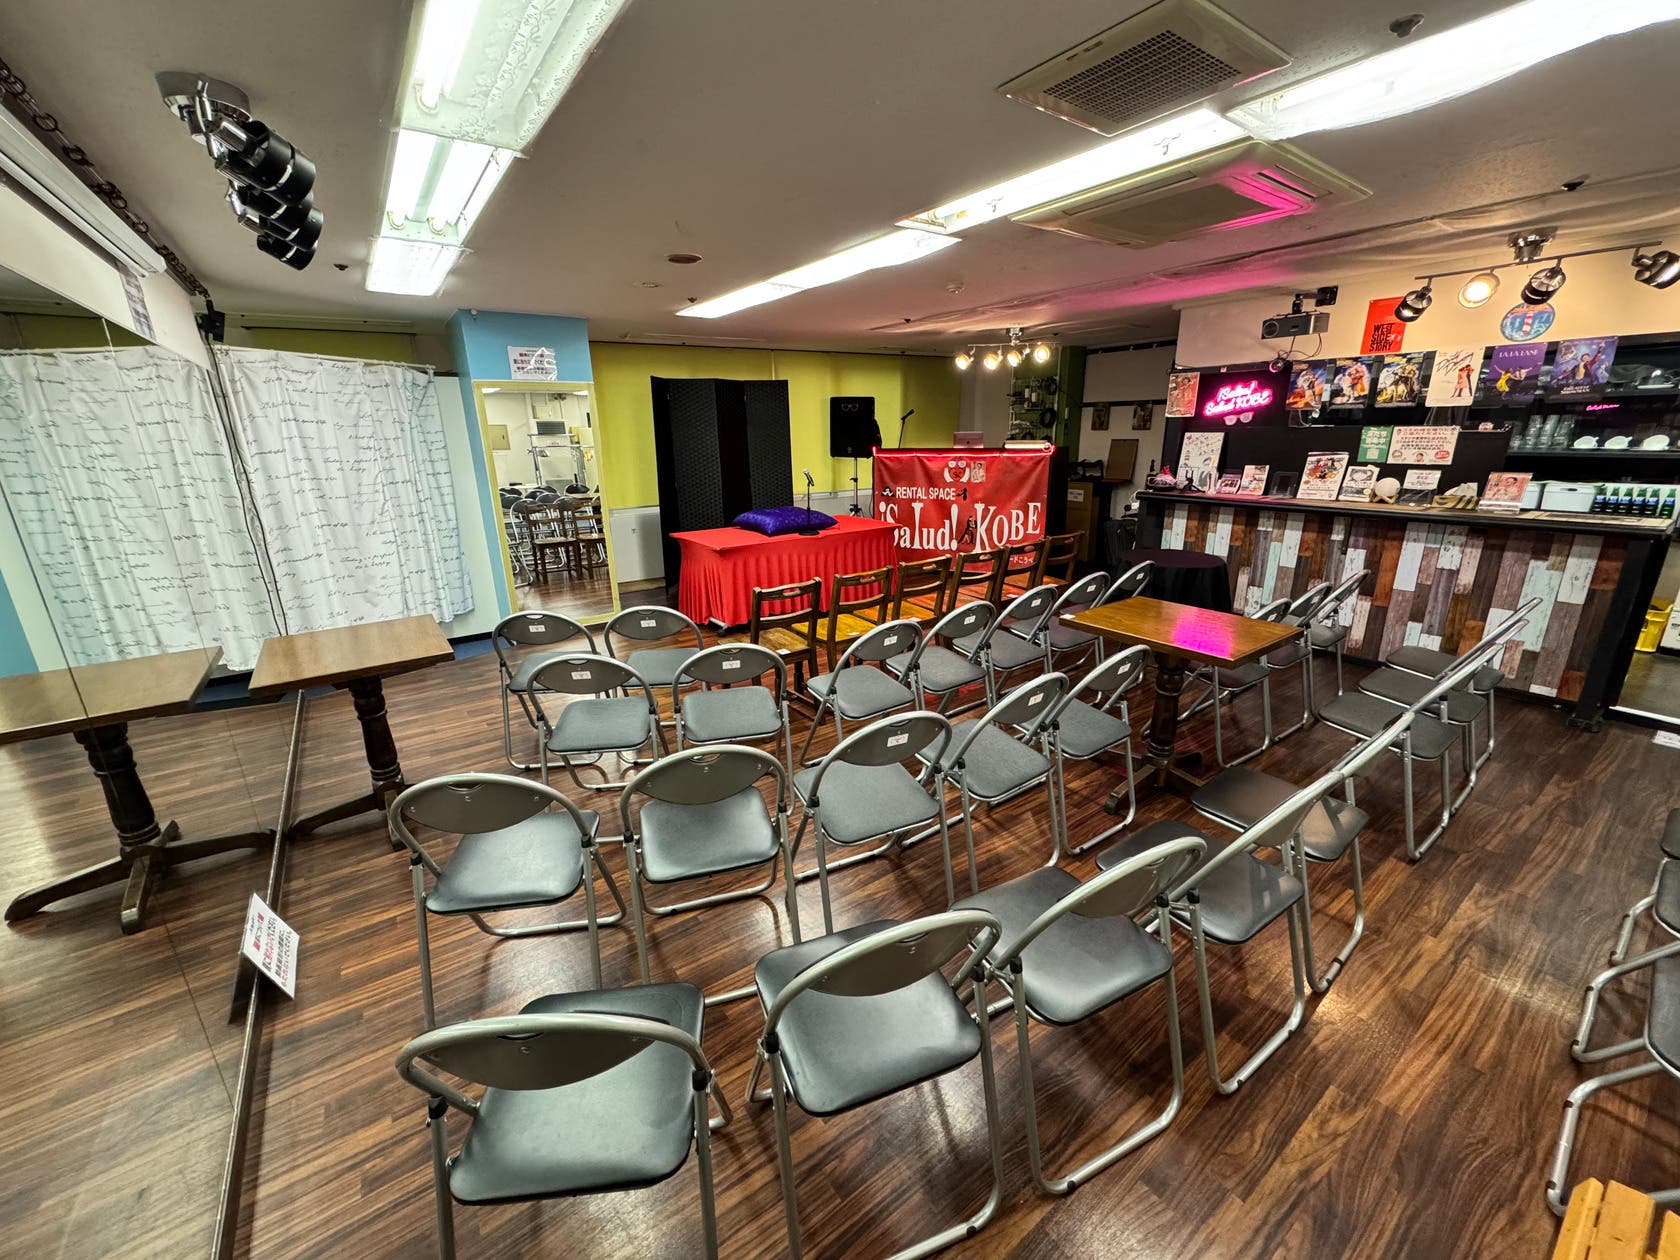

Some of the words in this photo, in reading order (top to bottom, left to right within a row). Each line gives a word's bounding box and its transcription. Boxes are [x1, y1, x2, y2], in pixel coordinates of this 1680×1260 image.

[1373, 323, 1395, 333] WEST
[1371, 332, 1392, 343] SIDE
[1369, 340, 1394, 352] STORY
[895, 486, 927, 500] RENTAL
[928, 487, 956, 501] SPACE
[973, 501, 1041, 553] KOBE
